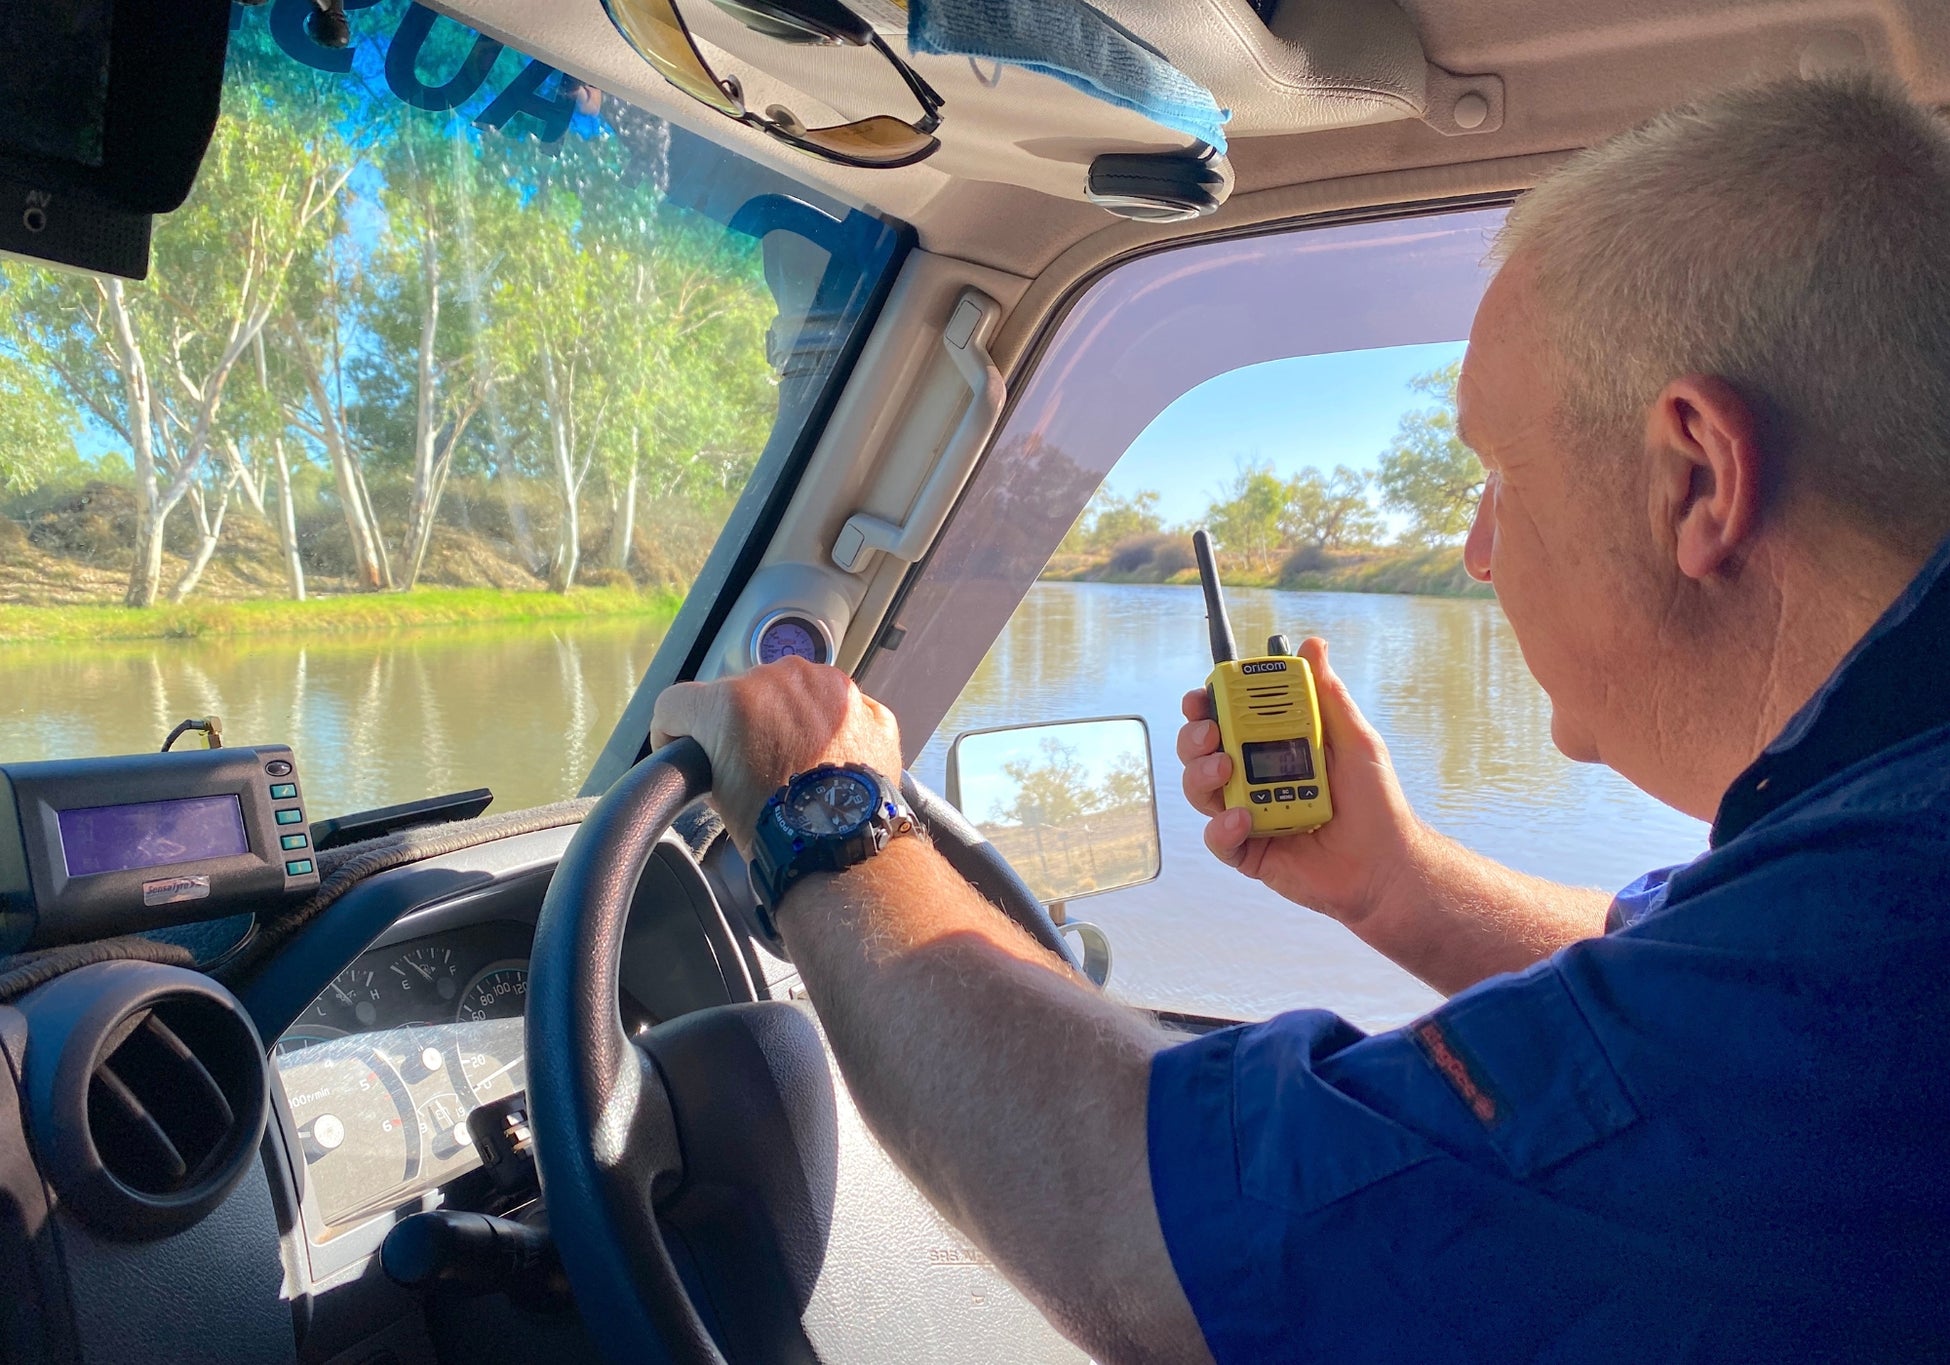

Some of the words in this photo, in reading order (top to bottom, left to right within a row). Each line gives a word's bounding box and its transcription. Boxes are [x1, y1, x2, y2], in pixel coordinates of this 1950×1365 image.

[1243, 661, 1286, 673] oricom
[449, 965, 457, 976] F
[401, 979, 411, 990] E
[492, 982, 511, 997] 100
[369, 988, 381, 1001] H
[480, 993, 495, 1006] 80
[316, 1006, 327, 1016] L
[471, 1009, 486, 1022] 60
[470, 1053, 486, 1069] 20
[359, 1078, 371, 1091] 5
[382, 1119, 393, 1133] 6
[929, 1249, 959, 1262] SRS
